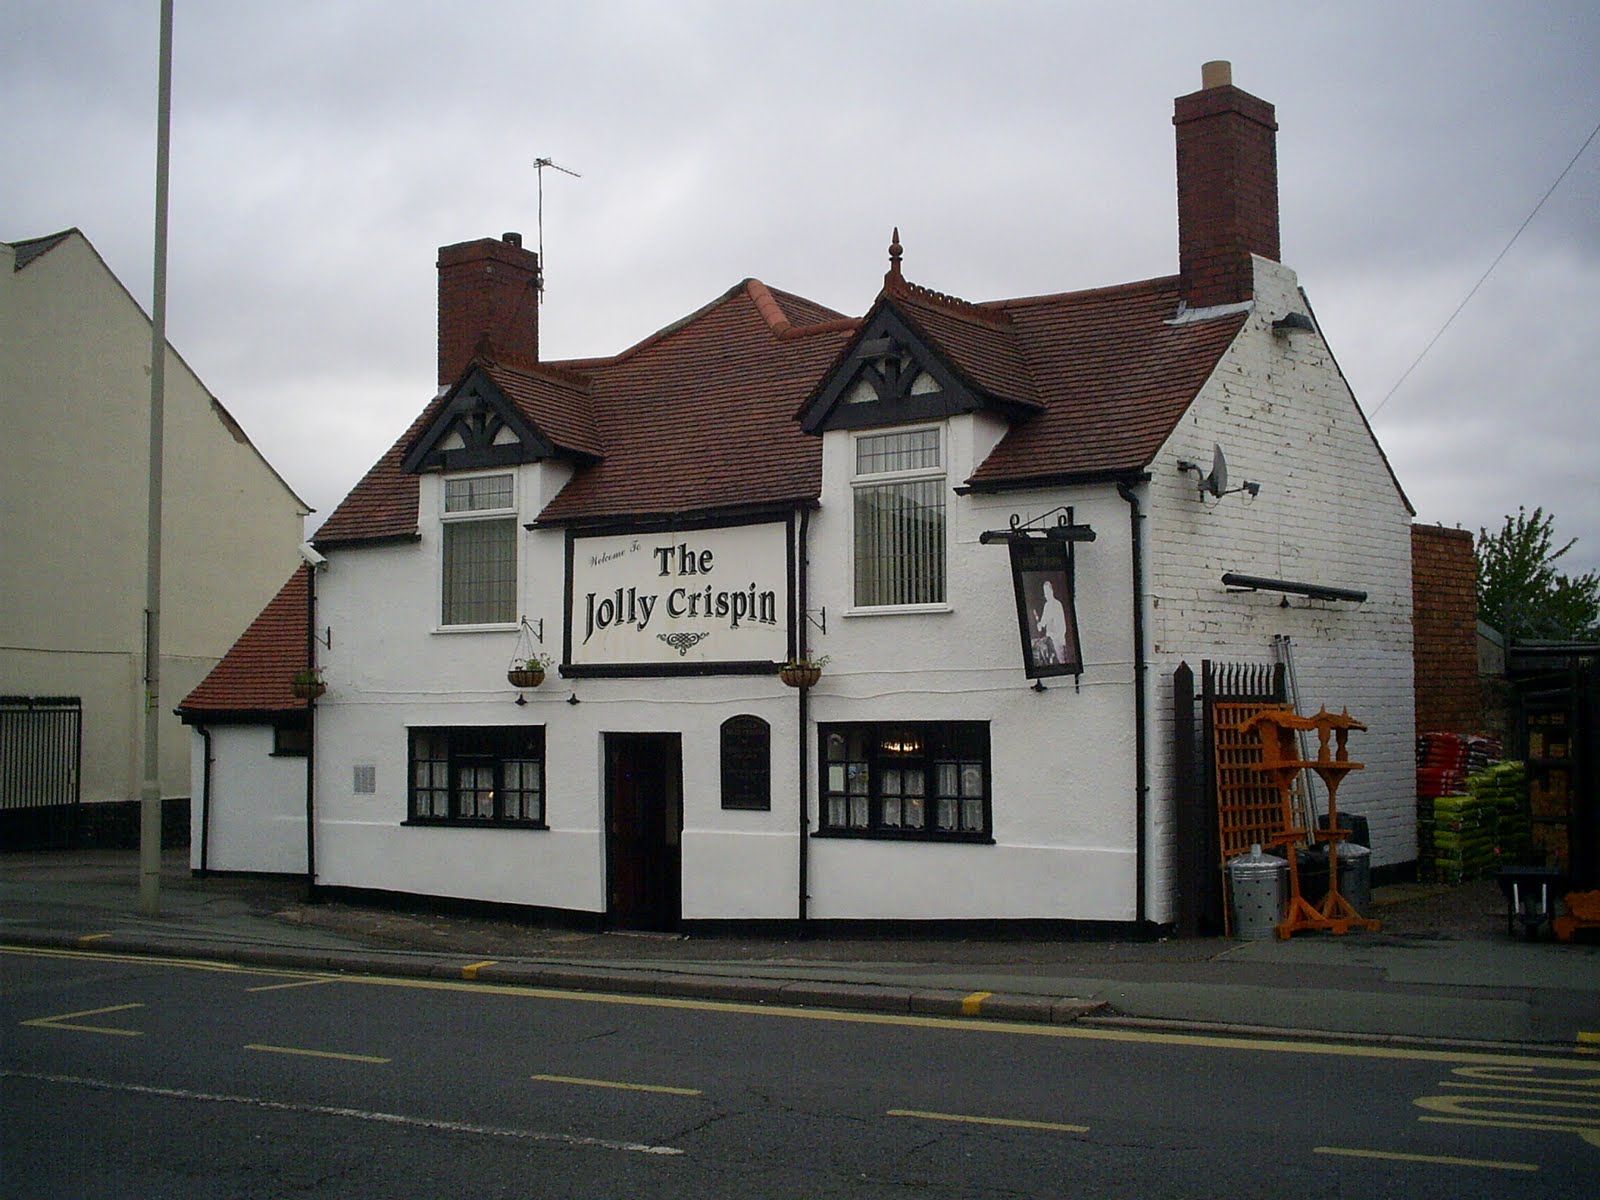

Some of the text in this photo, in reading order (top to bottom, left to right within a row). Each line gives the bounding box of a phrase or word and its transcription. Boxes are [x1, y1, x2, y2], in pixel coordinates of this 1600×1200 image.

[589, 540, 641, 567] Welcome To
[653, 543, 714, 576] The
[583, 583, 777, 645] Jolly Crispin
